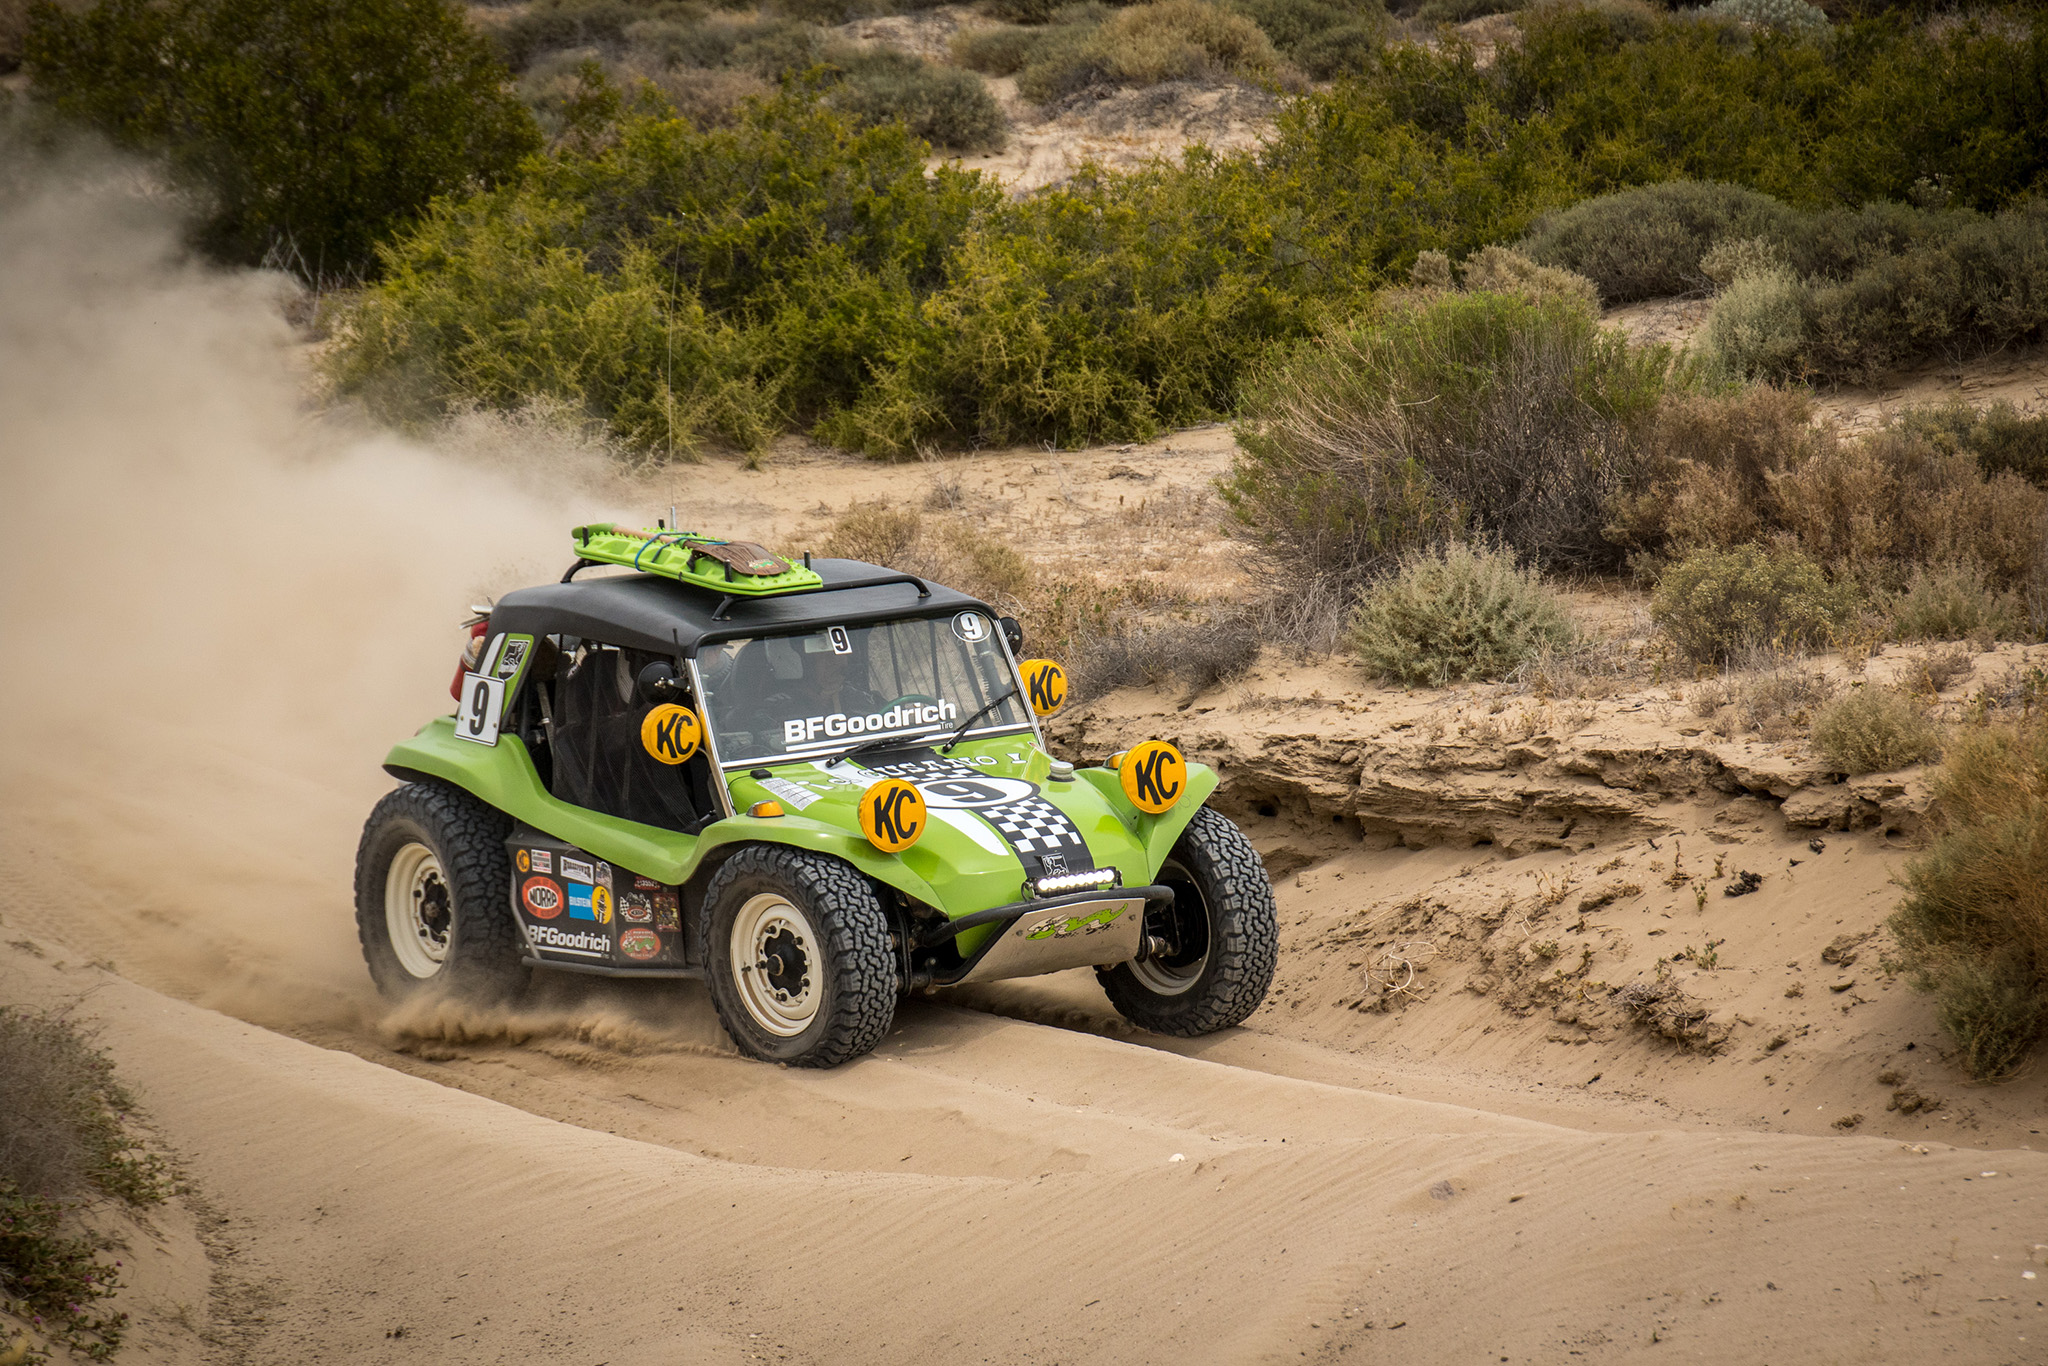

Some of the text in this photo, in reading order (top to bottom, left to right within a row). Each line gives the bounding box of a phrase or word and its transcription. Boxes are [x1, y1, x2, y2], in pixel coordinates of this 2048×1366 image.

[830, 627, 849, 652] 9
[960, 612, 983, 640] 9
[469, 680, 490, 736] 9
[1029, 665, 1063, 710] KC
[656, 713, 694, 759] KC
[784, 698, 957, 744] BFGoodrich
[924, 781, 1008, 803] 9
[1135, 749, 1179, 806] KC
[874, 786, 918, 845] KC
[529, 887, 558, 908] NORRA
[528, 924, 611, 952] BFGoodrich
